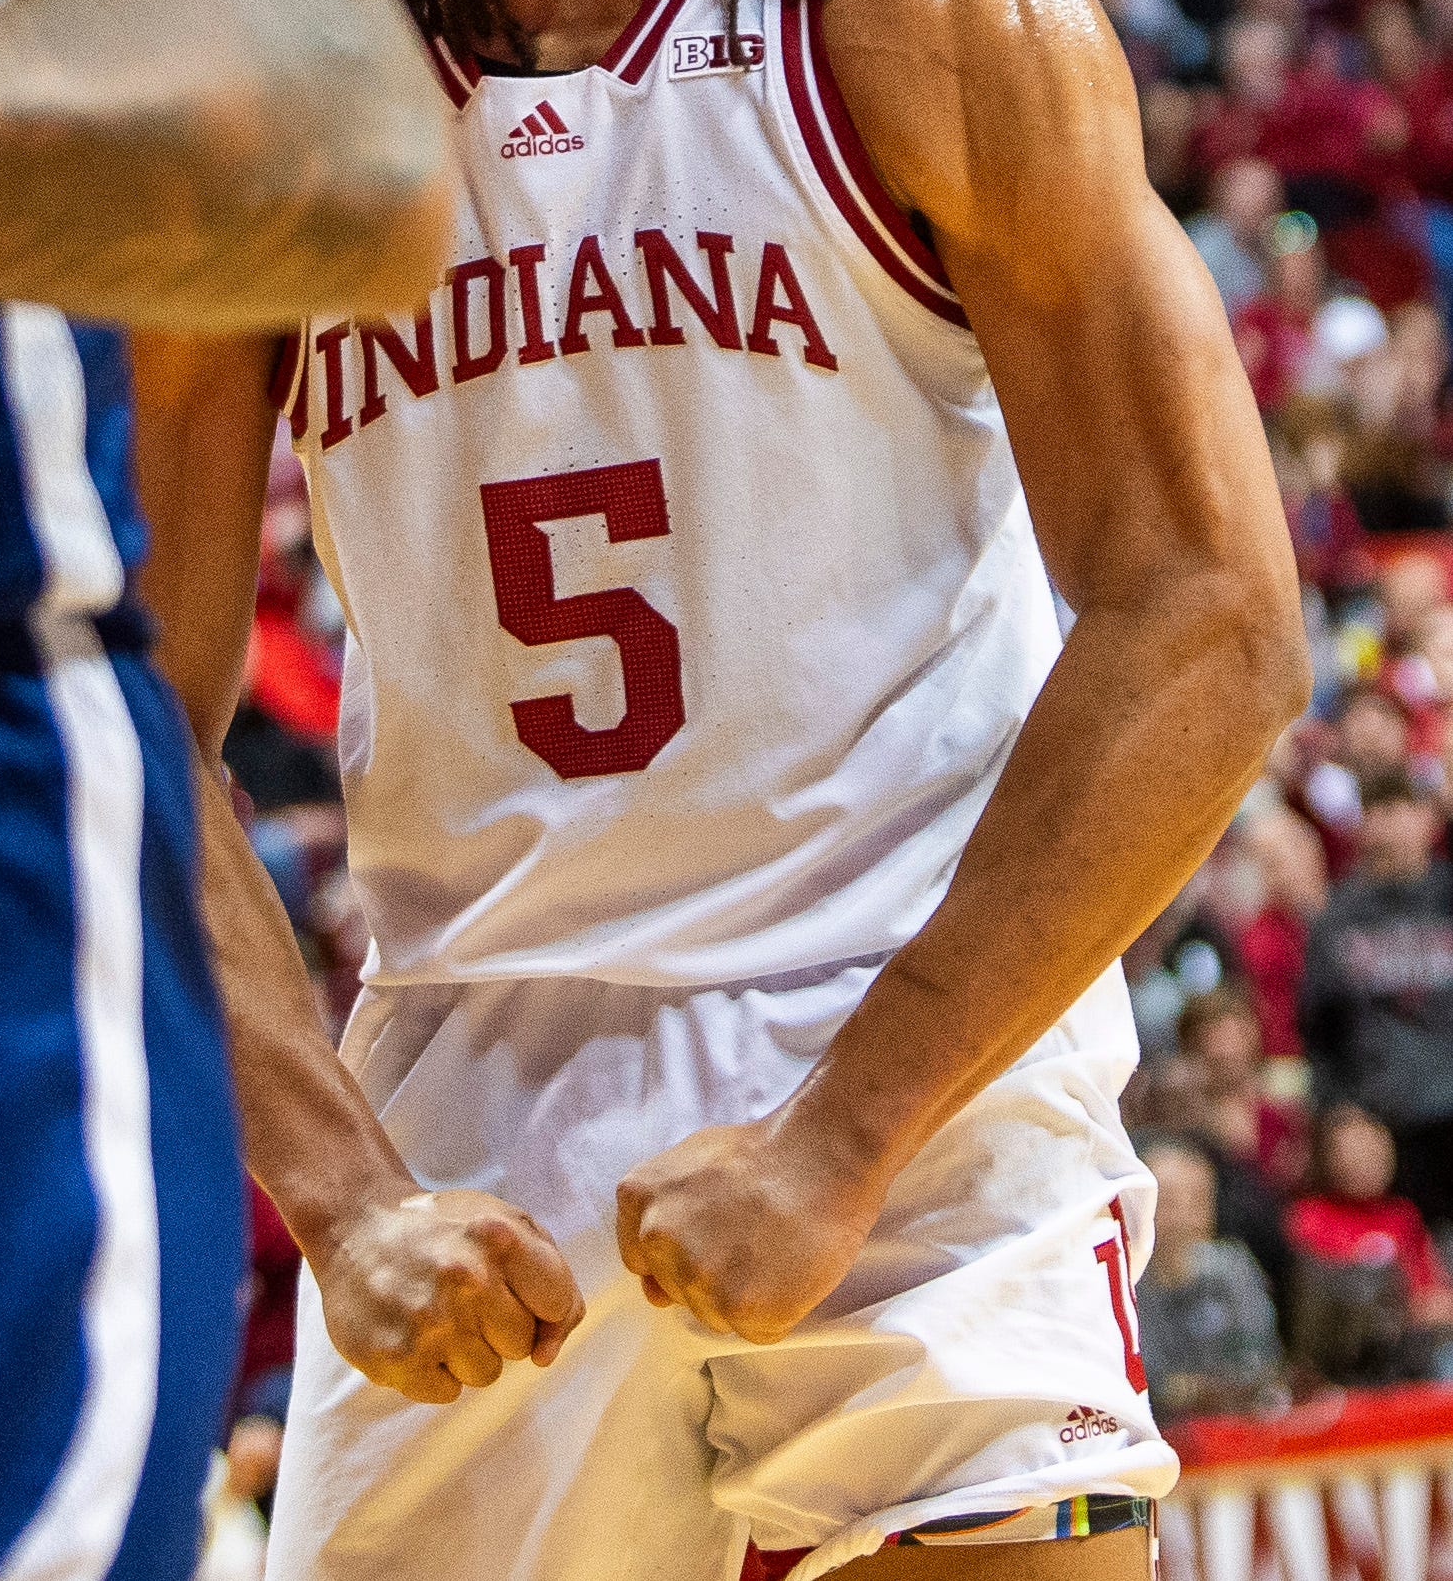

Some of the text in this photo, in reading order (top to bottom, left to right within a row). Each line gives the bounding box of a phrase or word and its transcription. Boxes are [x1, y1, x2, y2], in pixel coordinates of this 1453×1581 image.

[500, 134, 585, 159] adidas
[316, 229, 836, 450] INDIANA
[480, 458, 685, 778] 5
[1060, 1416, 1118, 1443] adidas
